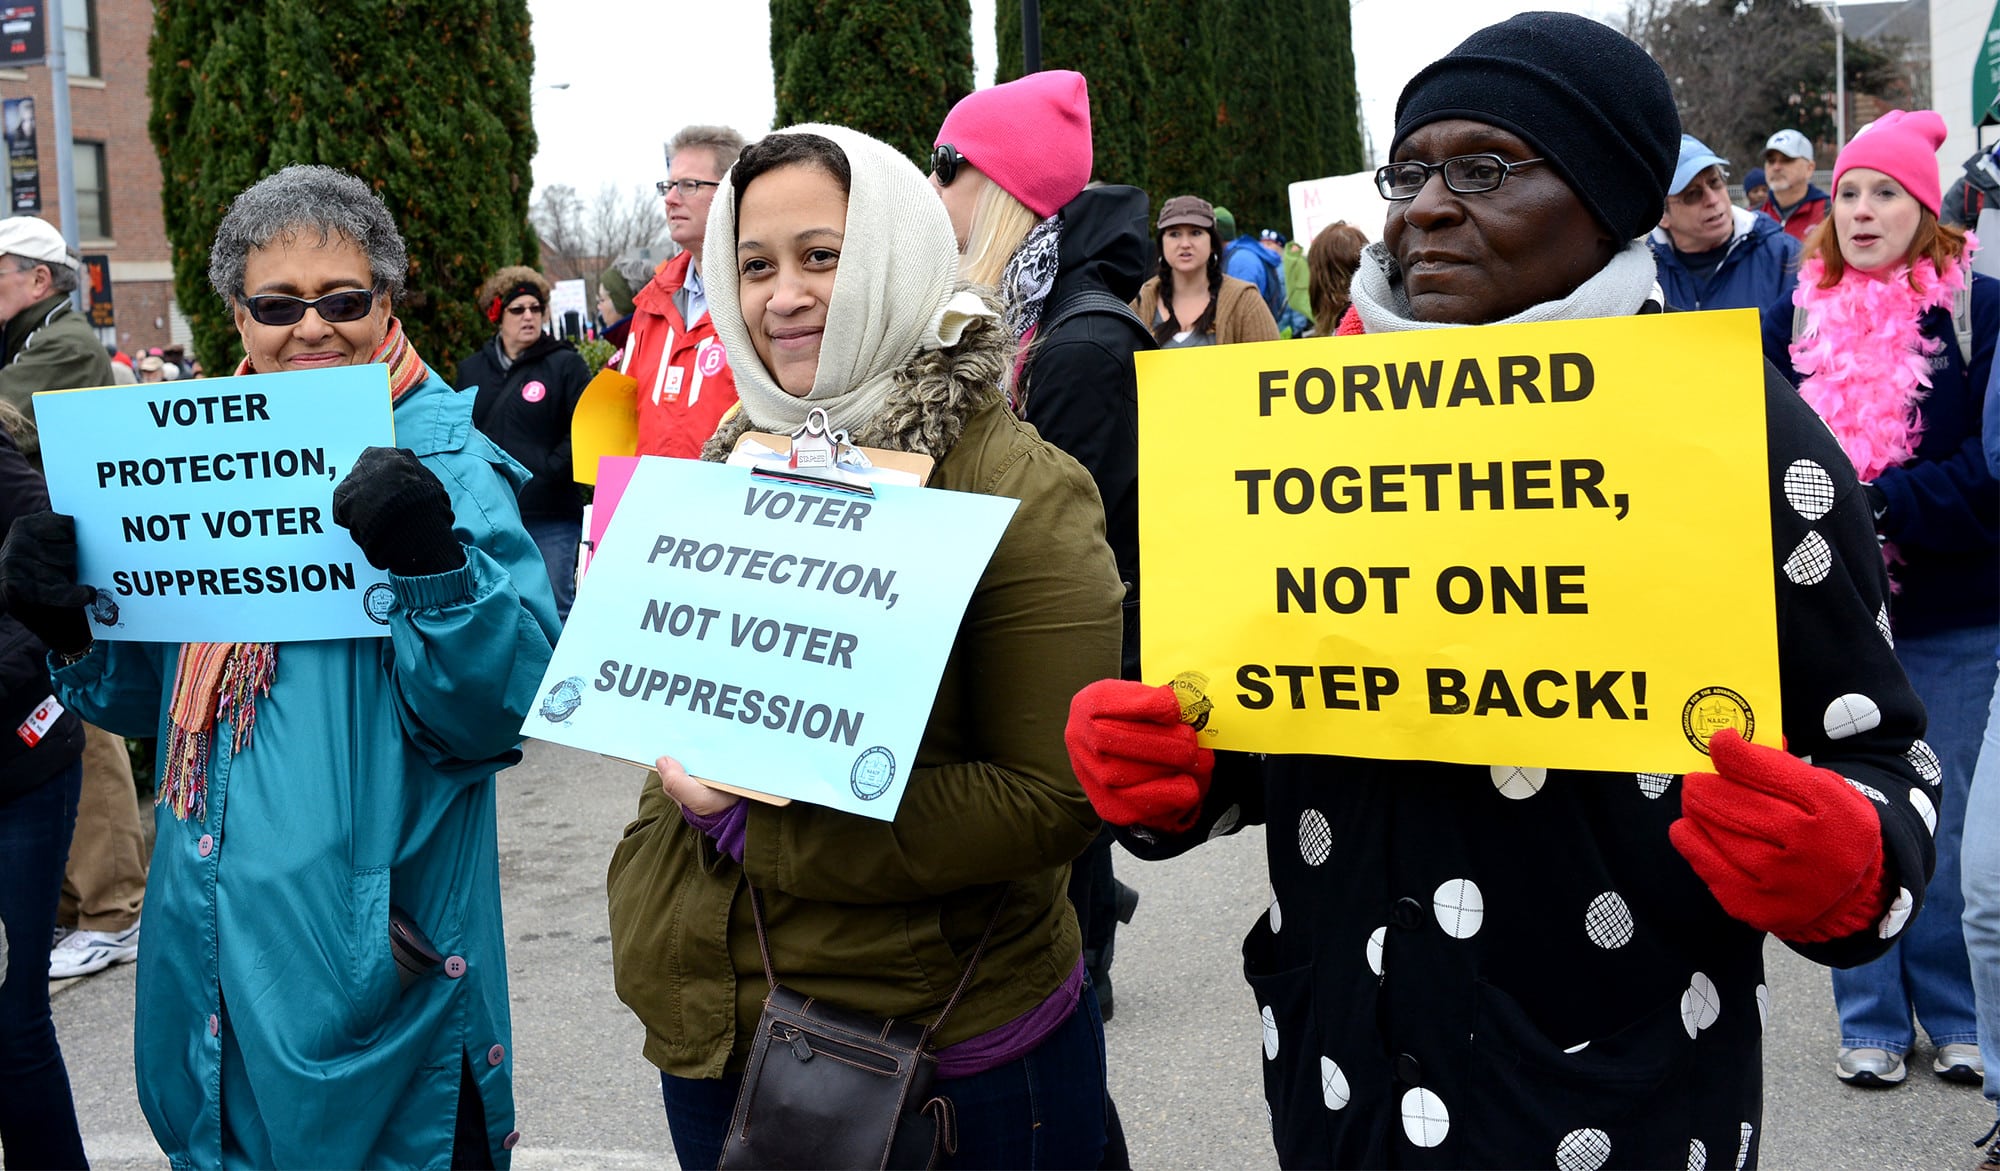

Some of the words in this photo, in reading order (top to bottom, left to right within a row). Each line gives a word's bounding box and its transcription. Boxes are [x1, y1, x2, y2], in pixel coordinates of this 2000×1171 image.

[147, 393, 271, 428] VOTER
[1258, 352, 1595, 417] FORWARD
[97, 447, 337, 488] PROTECTION,
[1234, 458, 1630, 521] TOGETHER,
[121, 513, 191, 543] NOT
[201, 506, 324, 539] VOTER
[743, 487, 872, 531] VOTER
[112, 562, 356, 597] SUPPRESSION
[647, 534, 899, 610] PROTECTION,
[1276, 566, 1410, 615] NOT
[1436, 565, 1589, 615] ONE
[640, 598, 721, 641] NOT
[730, 613, 859, 670] VOTER
[594, 659, 865, 747] SUPPRESSION
[1236, 664, 1400, 712] STEP
[1425, 668, 1649, 721] BACK!
